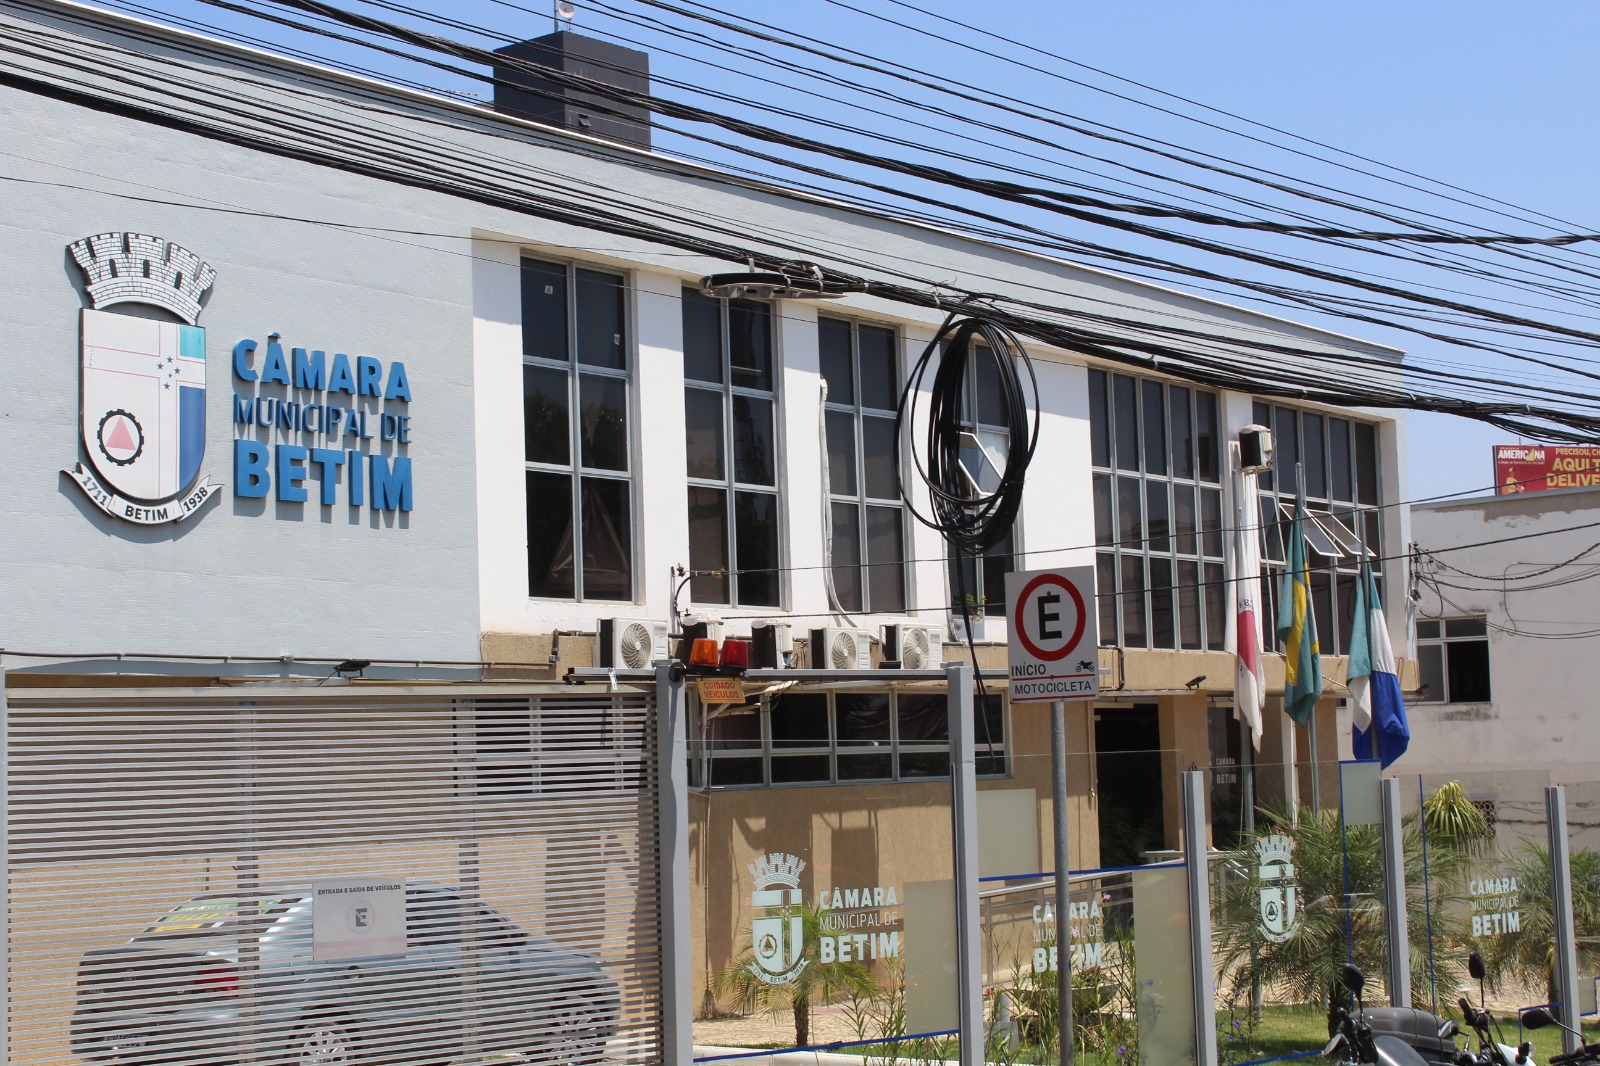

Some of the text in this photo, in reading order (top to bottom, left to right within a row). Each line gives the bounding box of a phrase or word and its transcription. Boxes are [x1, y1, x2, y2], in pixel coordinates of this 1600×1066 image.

[232, 331, 412, 402] CÂMARA
[233, 393, 412, 444] MUNICIPAL DE
[233, 439, 413, 512] BETIM
[1552, 457, 1590, 472] AQUI
[82, 476, 208, 522] 1711 BETIM 1938
[1037, 594, 1063, 641] E
[1011, 662, 1046, 677] INÍCIO
[704, 681, 736, 690] CUIDADO
[1014, 680, 1092, 695] MOTOCICLETA
[1216, 773, 1237, 785] BETIM
[317, 888, 343, 896] ENTRADA
[349, 885, 366, 893] SAÍDA
[819, 886, 898, 910] CÂMARA
[819, 911, 899, 931] MUNICIPAL DE
[1032, 901, 1100, 923] CÂARA
[1471, 911, 1520, 937] BETIM
[820, 931, 899, 964] BETIM
[1033, 942, 1102, 972] BEIM
[770, 975, 788, 984] BETIM
